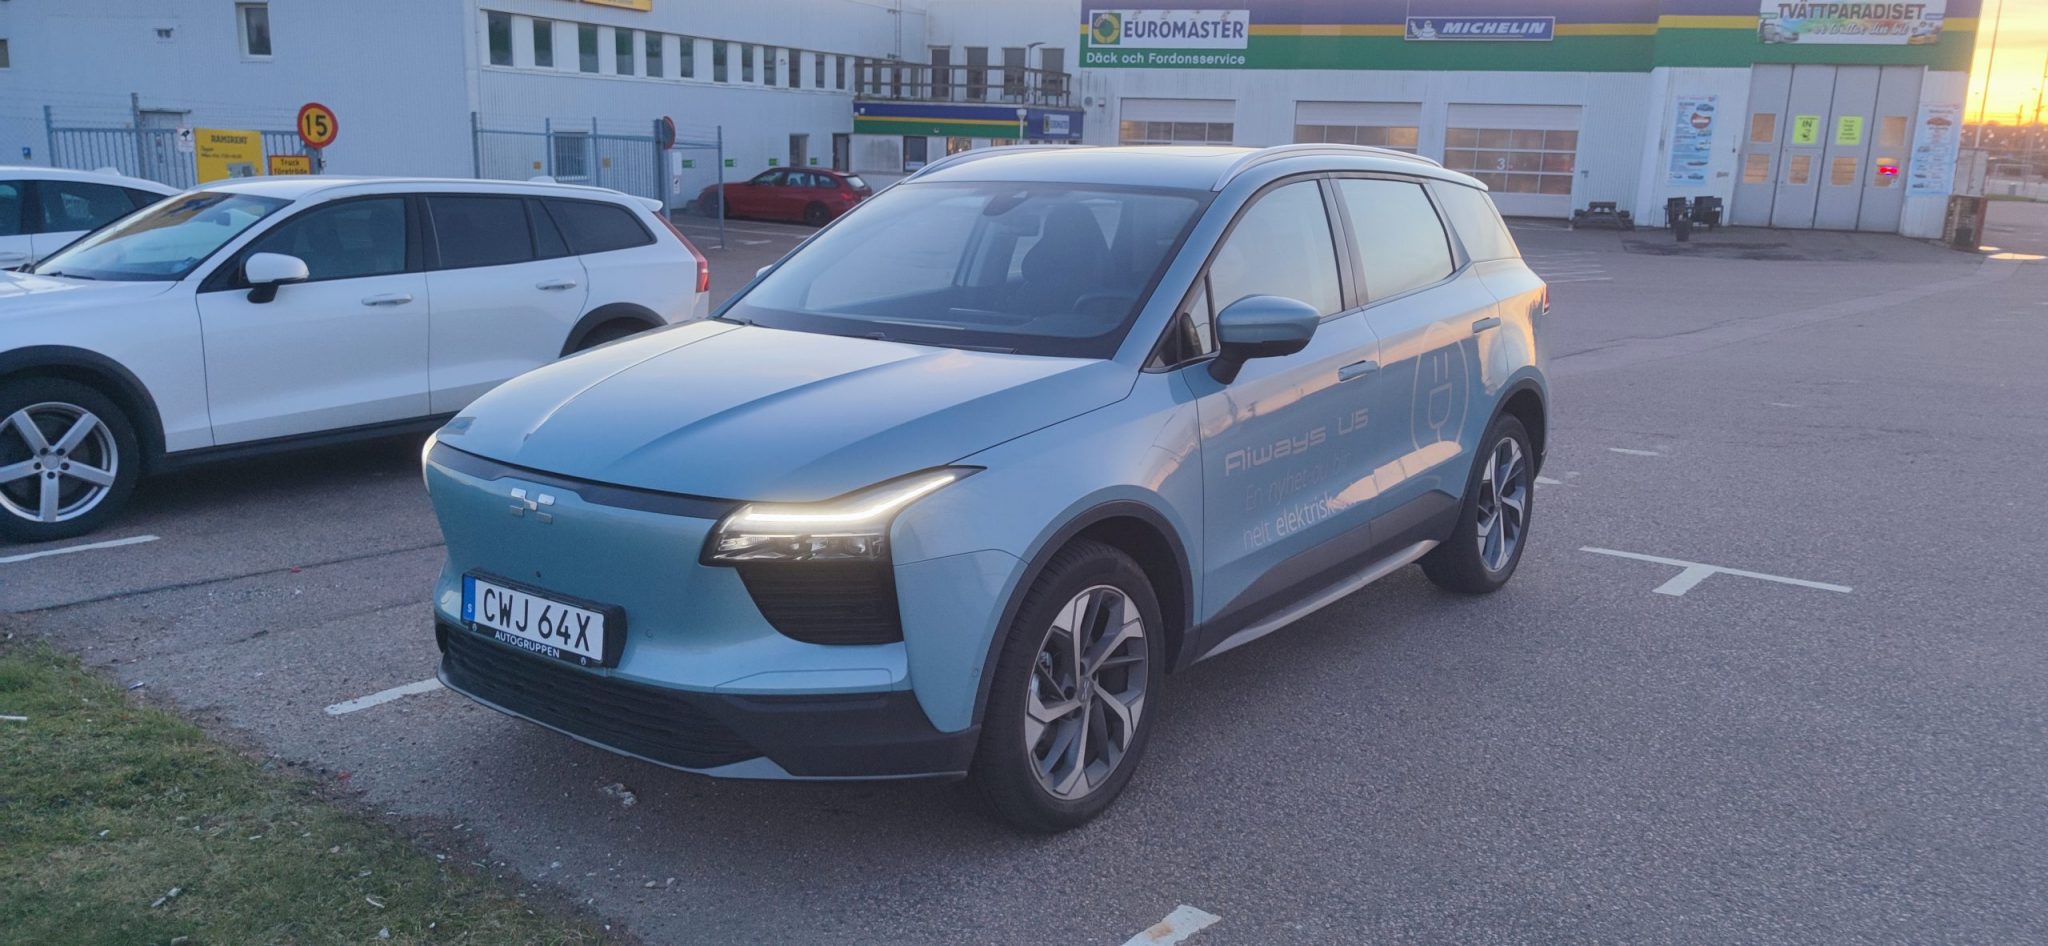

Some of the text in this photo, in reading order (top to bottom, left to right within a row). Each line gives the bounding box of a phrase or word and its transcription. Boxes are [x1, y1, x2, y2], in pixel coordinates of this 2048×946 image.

[1124, 20, 1245, 39] EUROMASTER
[1442, 21, 1547, 34] MICHELIN
[1086, 52, 1246, 65] Däck och Fordonsservice
[305, 113, 328, 137] 15
[466, 602, 473, 614] S
[483, 587, 592, 653] CWJ 64X
[494, 631, 561, 659] AUTOGRUPPEN
